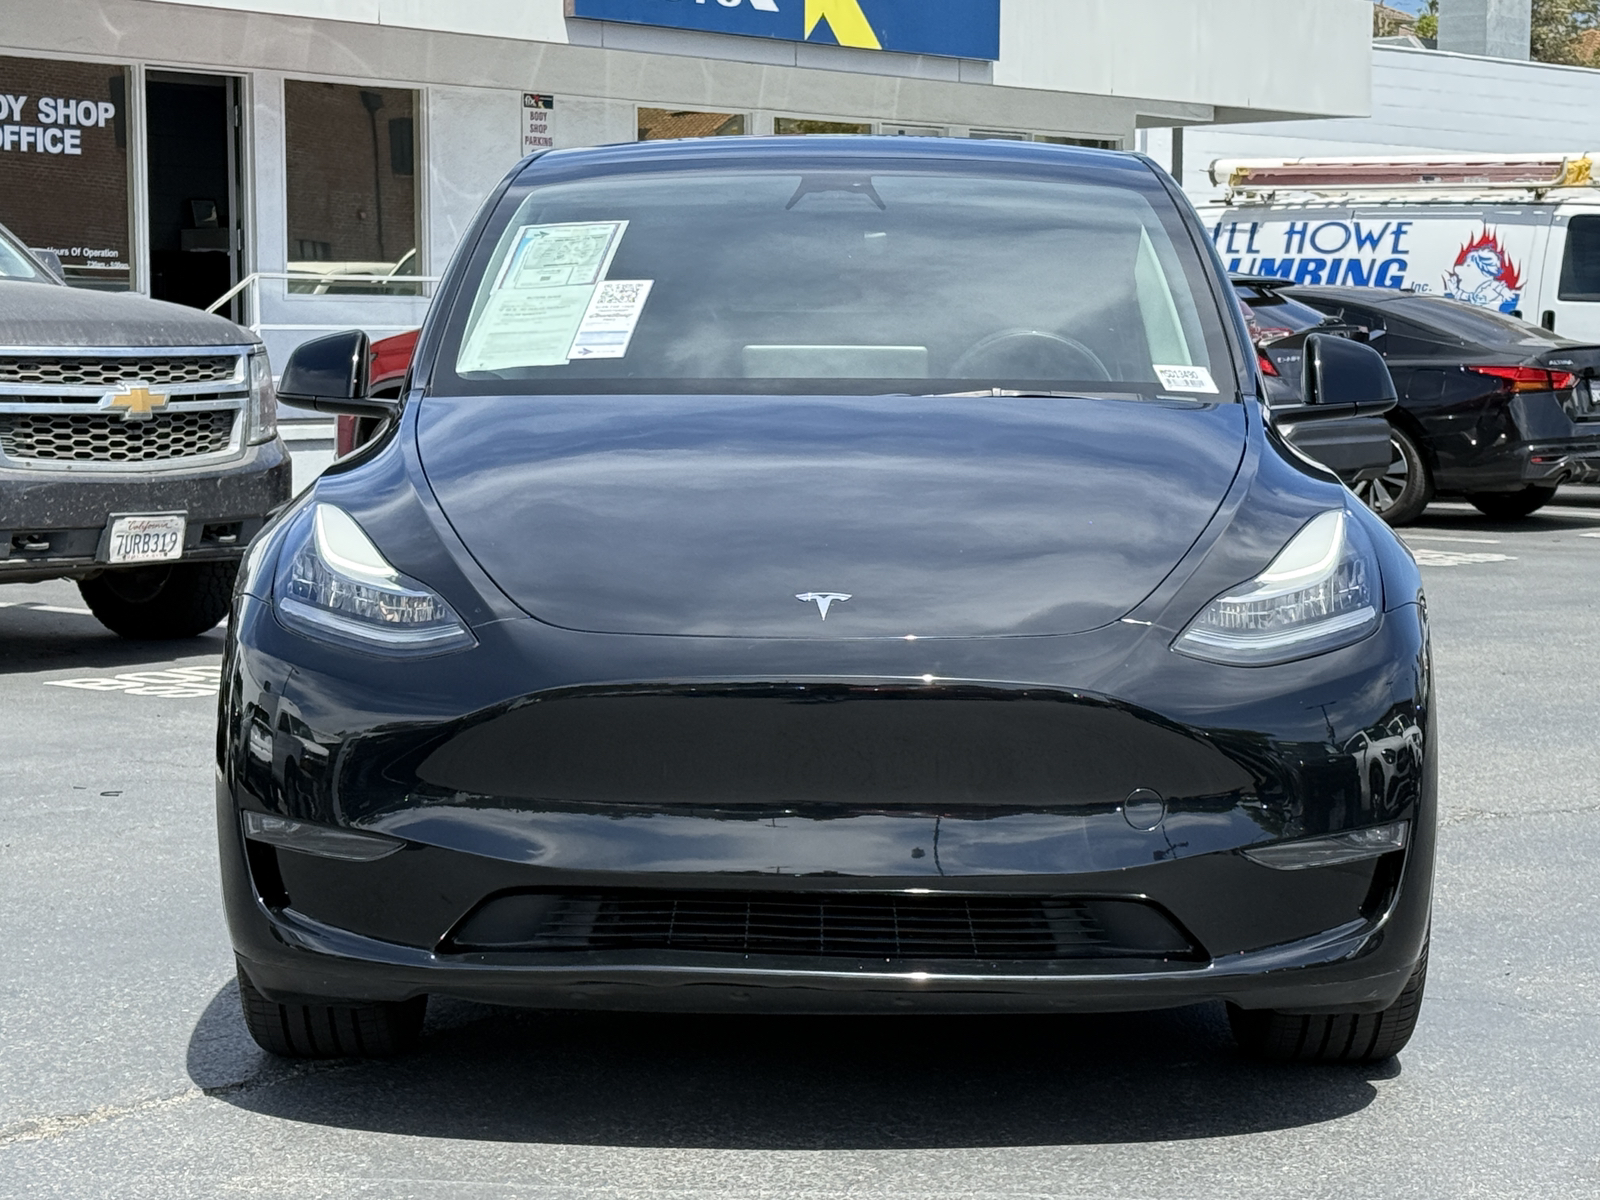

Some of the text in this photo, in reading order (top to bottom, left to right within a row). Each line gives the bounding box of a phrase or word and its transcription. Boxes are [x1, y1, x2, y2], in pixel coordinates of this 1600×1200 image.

[38, 97, 116, 128] SHOP
[530, 111, 547, 122] BODY
[530, 124, 548, 134] SHOP
[0, 124, 82, 155] FFICE
[525, 135, 553, 147] PARKING
[1284, 221, 1412, 255] HOWE
[71, 247, 81, 256] Of
[83, 248, 118, 258] Operation
[128, 520, 170, 533] California
[116, 531, 178, 556] 7URB319
